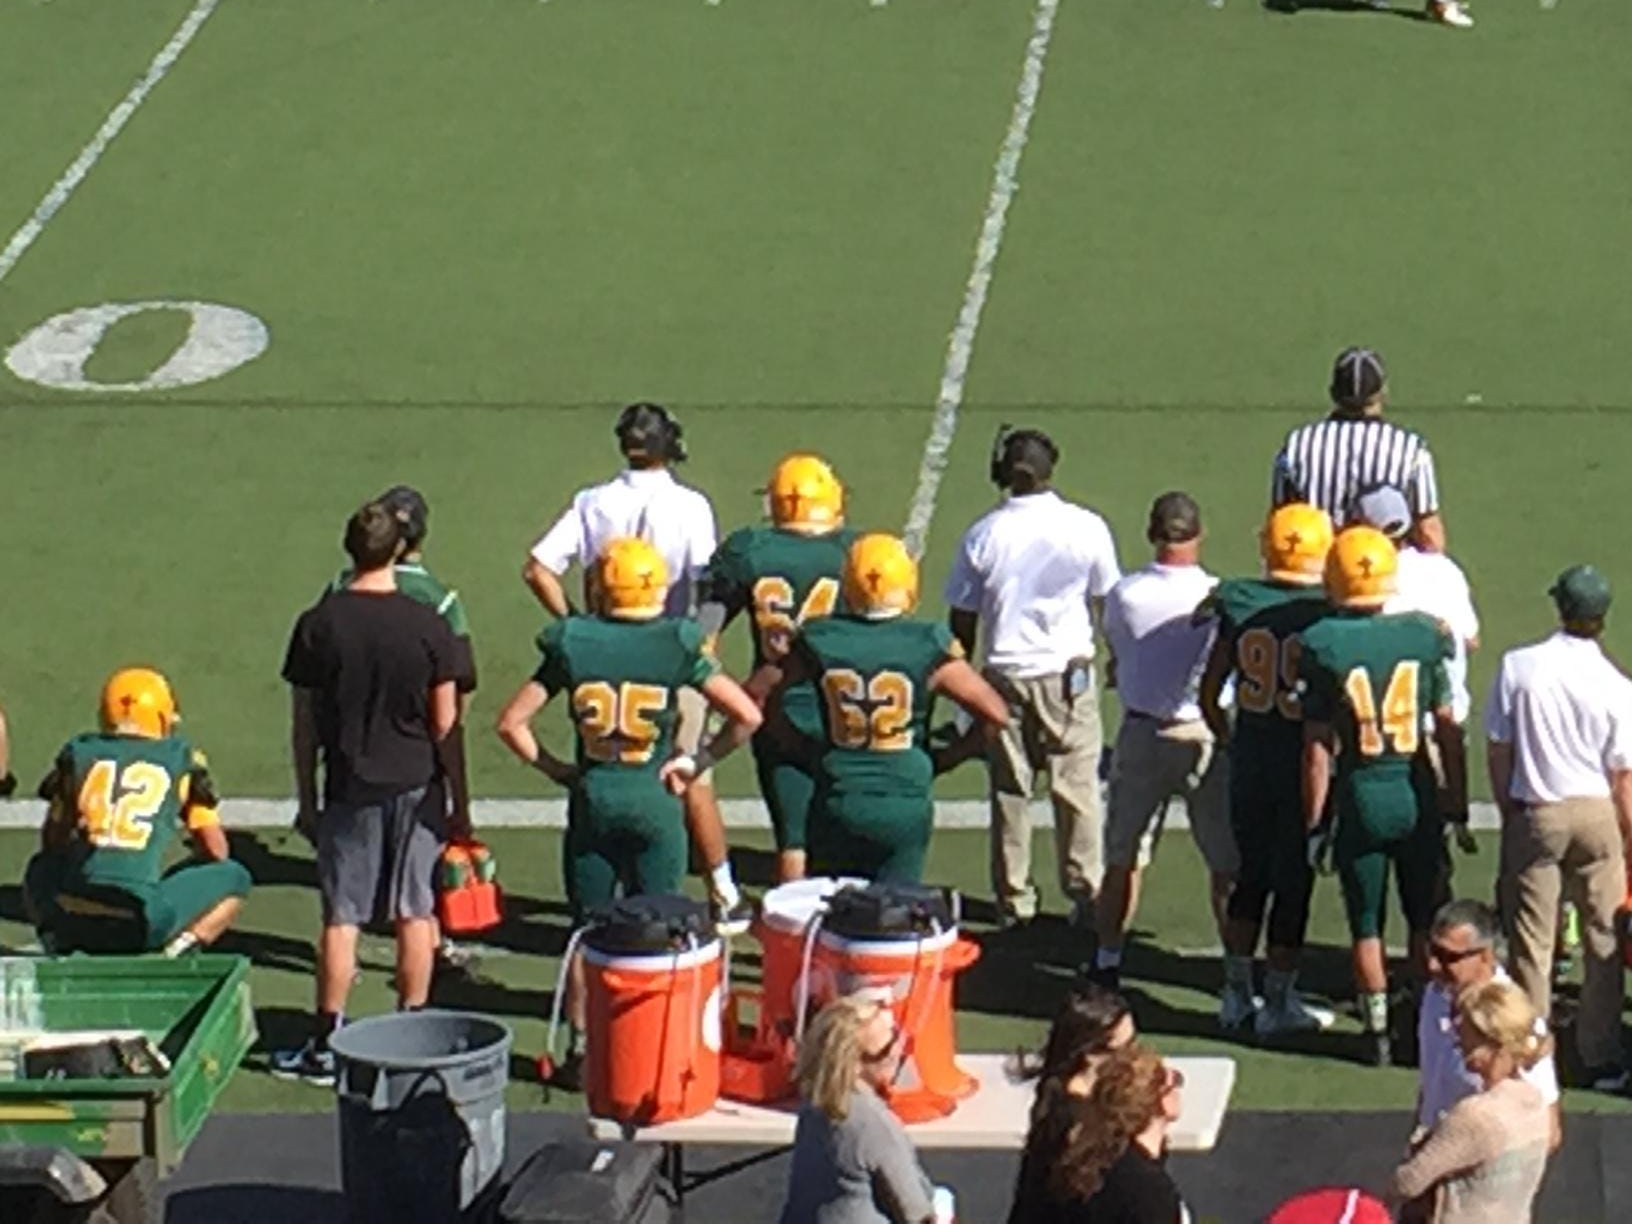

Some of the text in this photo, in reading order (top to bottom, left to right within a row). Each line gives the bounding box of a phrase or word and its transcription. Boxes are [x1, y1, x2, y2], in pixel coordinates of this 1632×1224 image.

[822, 668, 914, 751] 62
[1345, 659, 1421, 756] 14
[78, 760, 172, 850] 42
